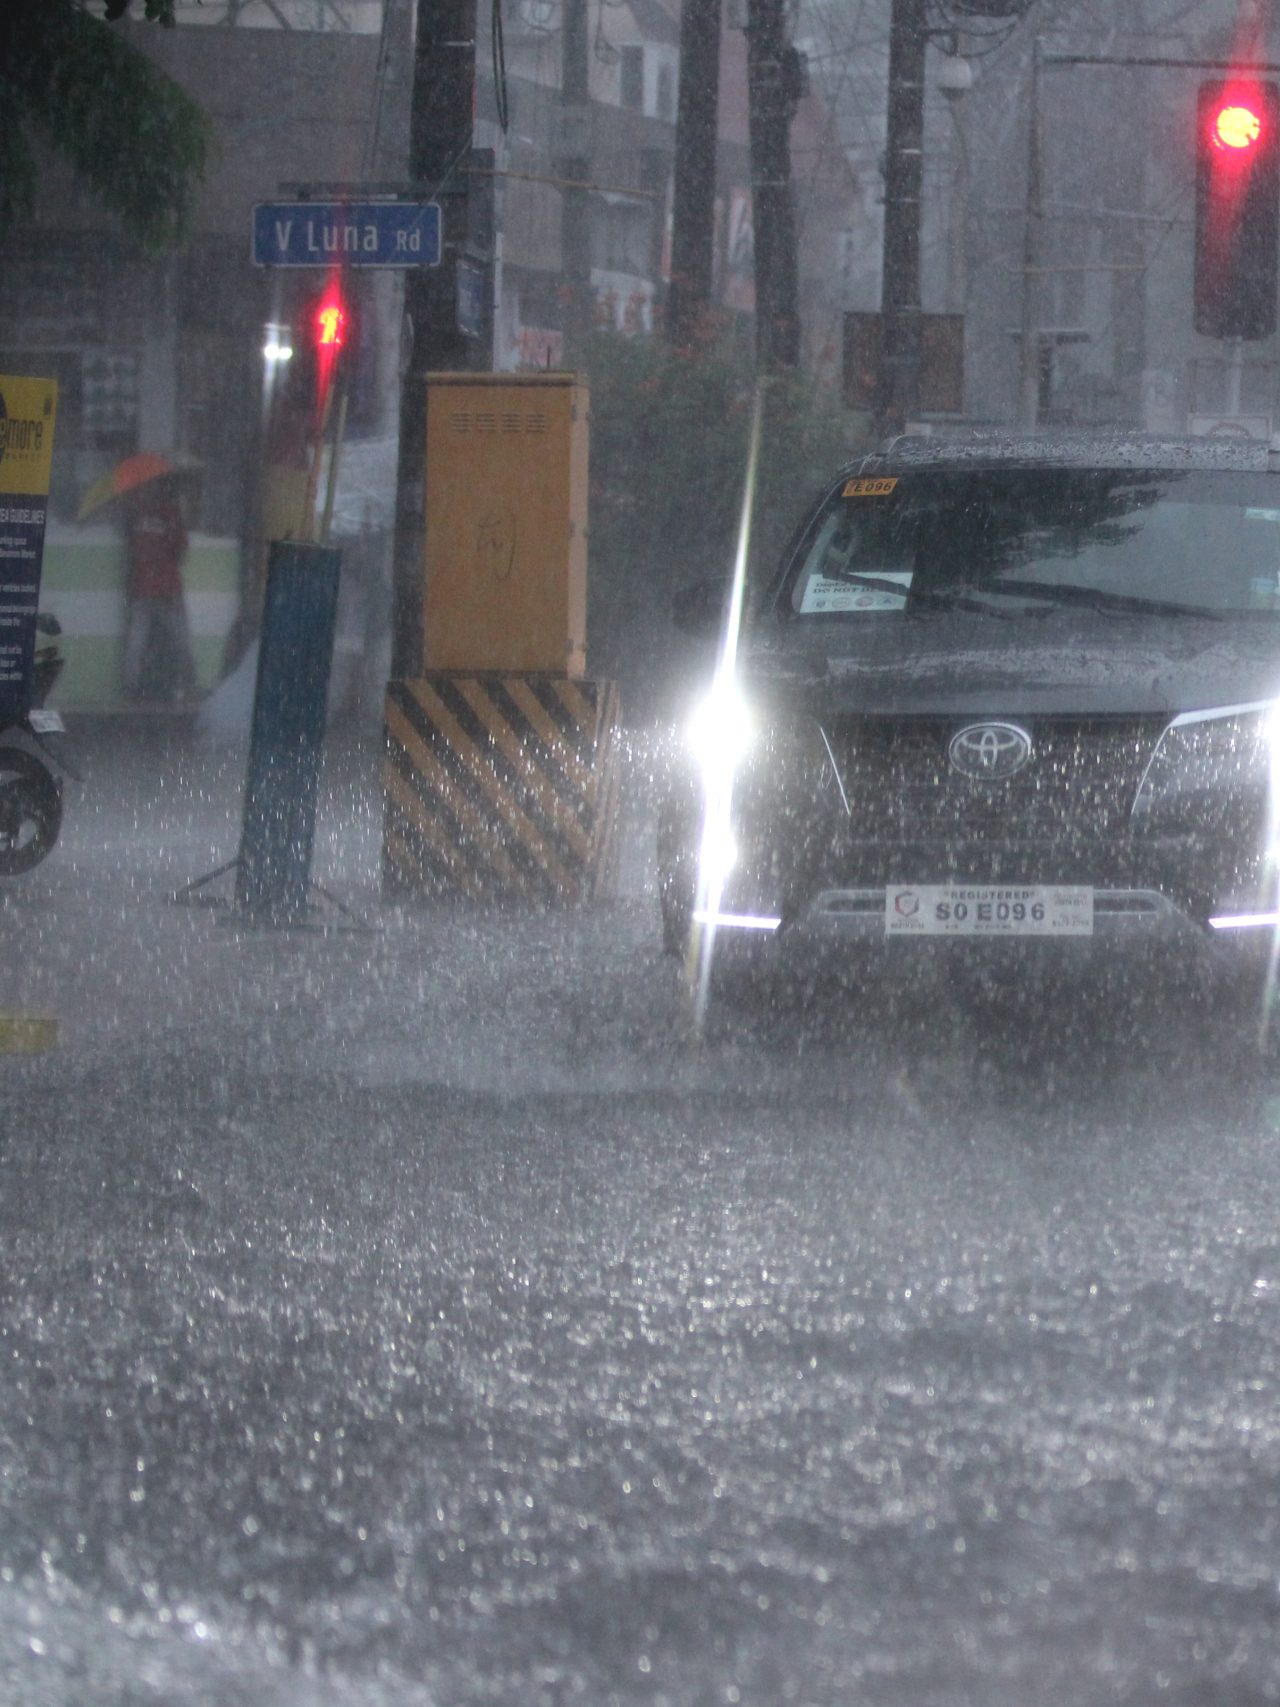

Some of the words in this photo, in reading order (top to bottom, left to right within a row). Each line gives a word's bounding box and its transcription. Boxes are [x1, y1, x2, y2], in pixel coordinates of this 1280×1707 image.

[275, 220, 292, 251] V
[307, 220, 378, 251] Luna
[397, 229, 421, 251] Rd
